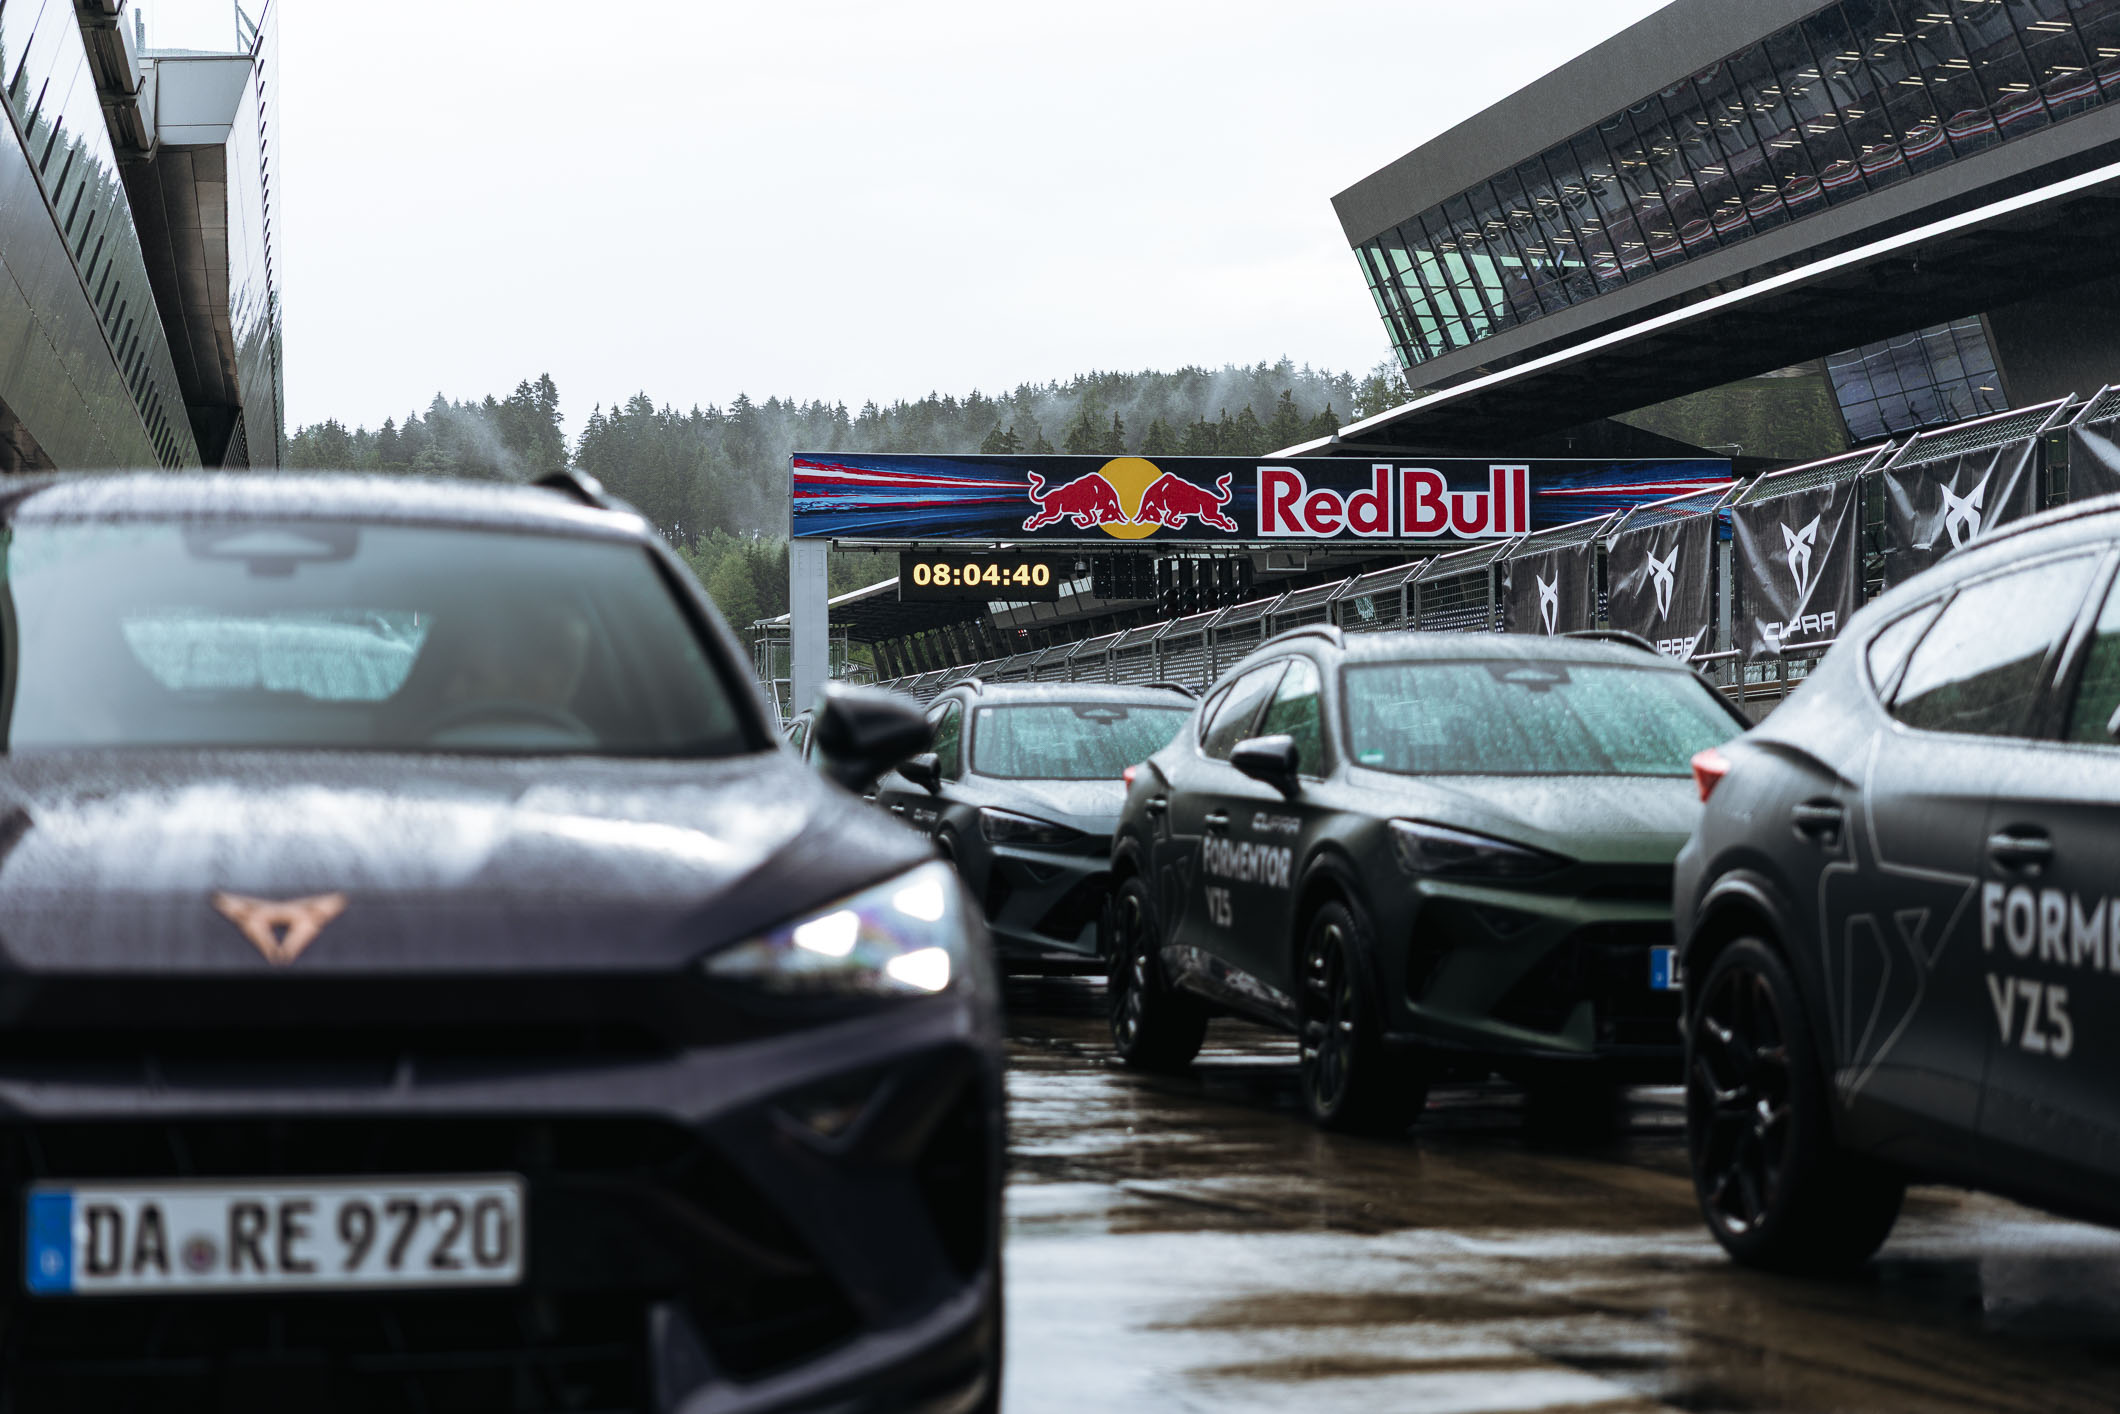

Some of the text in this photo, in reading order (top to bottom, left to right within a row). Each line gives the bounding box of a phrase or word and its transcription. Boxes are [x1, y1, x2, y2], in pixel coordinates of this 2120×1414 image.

[1257, 465, 1530, 538] Red Bull
[913, 563, 1050, 586] 08:04:40
[1763, 611, 1836, 640] CUPRA
[1203, 837, 1291, 887] FORMENTOR
[1986, 973, 2073, 1058] VZ5
[84, 1197, 508, 1277] DA RE 9720
